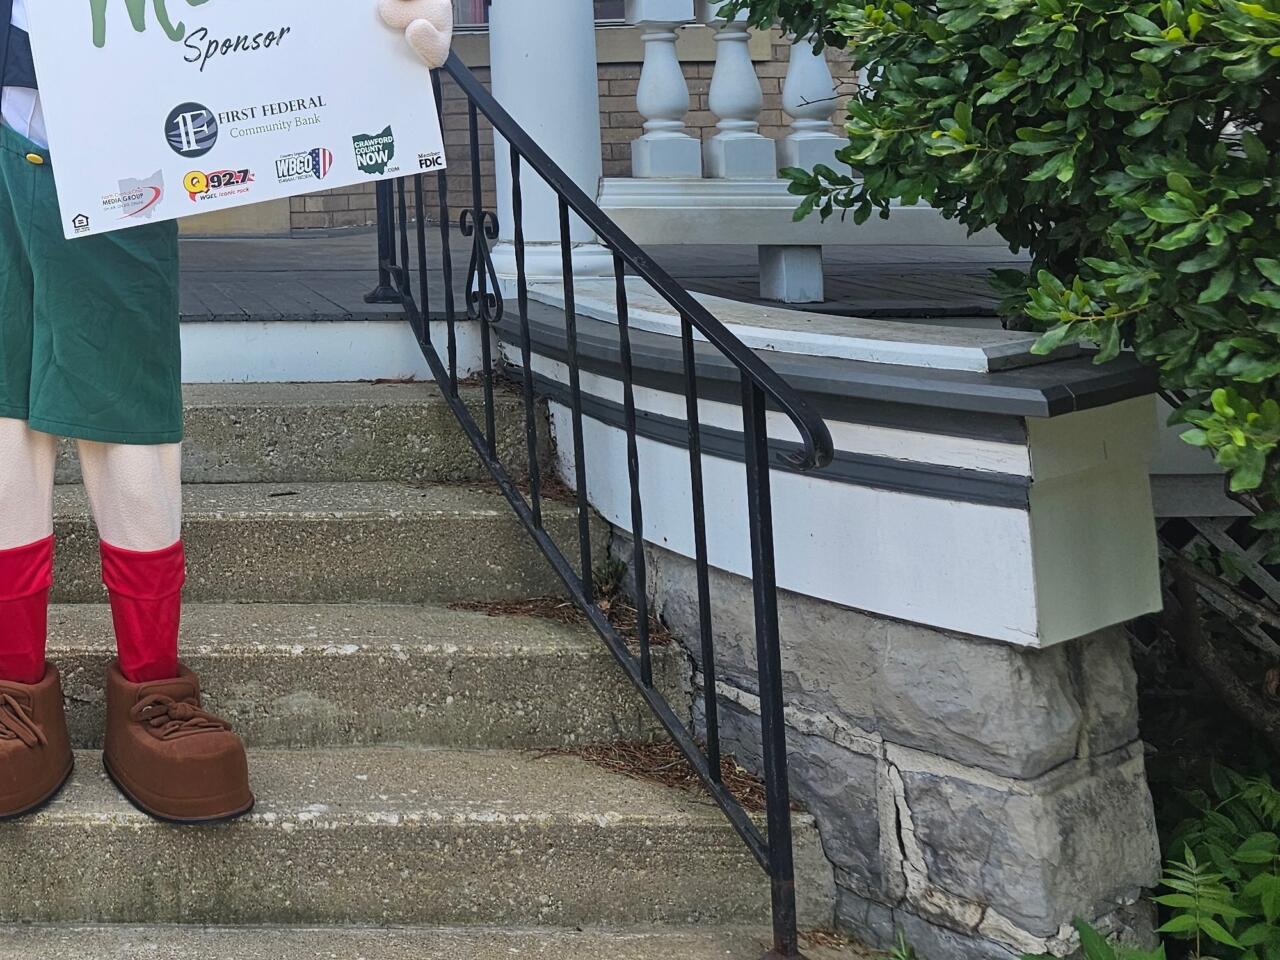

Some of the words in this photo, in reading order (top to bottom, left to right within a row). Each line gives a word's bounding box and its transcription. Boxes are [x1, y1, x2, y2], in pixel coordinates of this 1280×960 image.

[183, 27, 291, 72] Sponsor
[218, 107, 257, 124] FIRST
[262, 95, 326, 117] FEDERAL
[230, 120, 292, 138] Community
[295, 113, 321, 127] Bank
[354, 136, 393, 148] CRAWFORD
[355, 144, 383, 155] COUNTY
[357, 150, 388, 166] NOW
[419, 156, 442, 168] FDIC
[103, 197, 122, 205] MEDIA
[123, 193, 143, 201] GROUP
